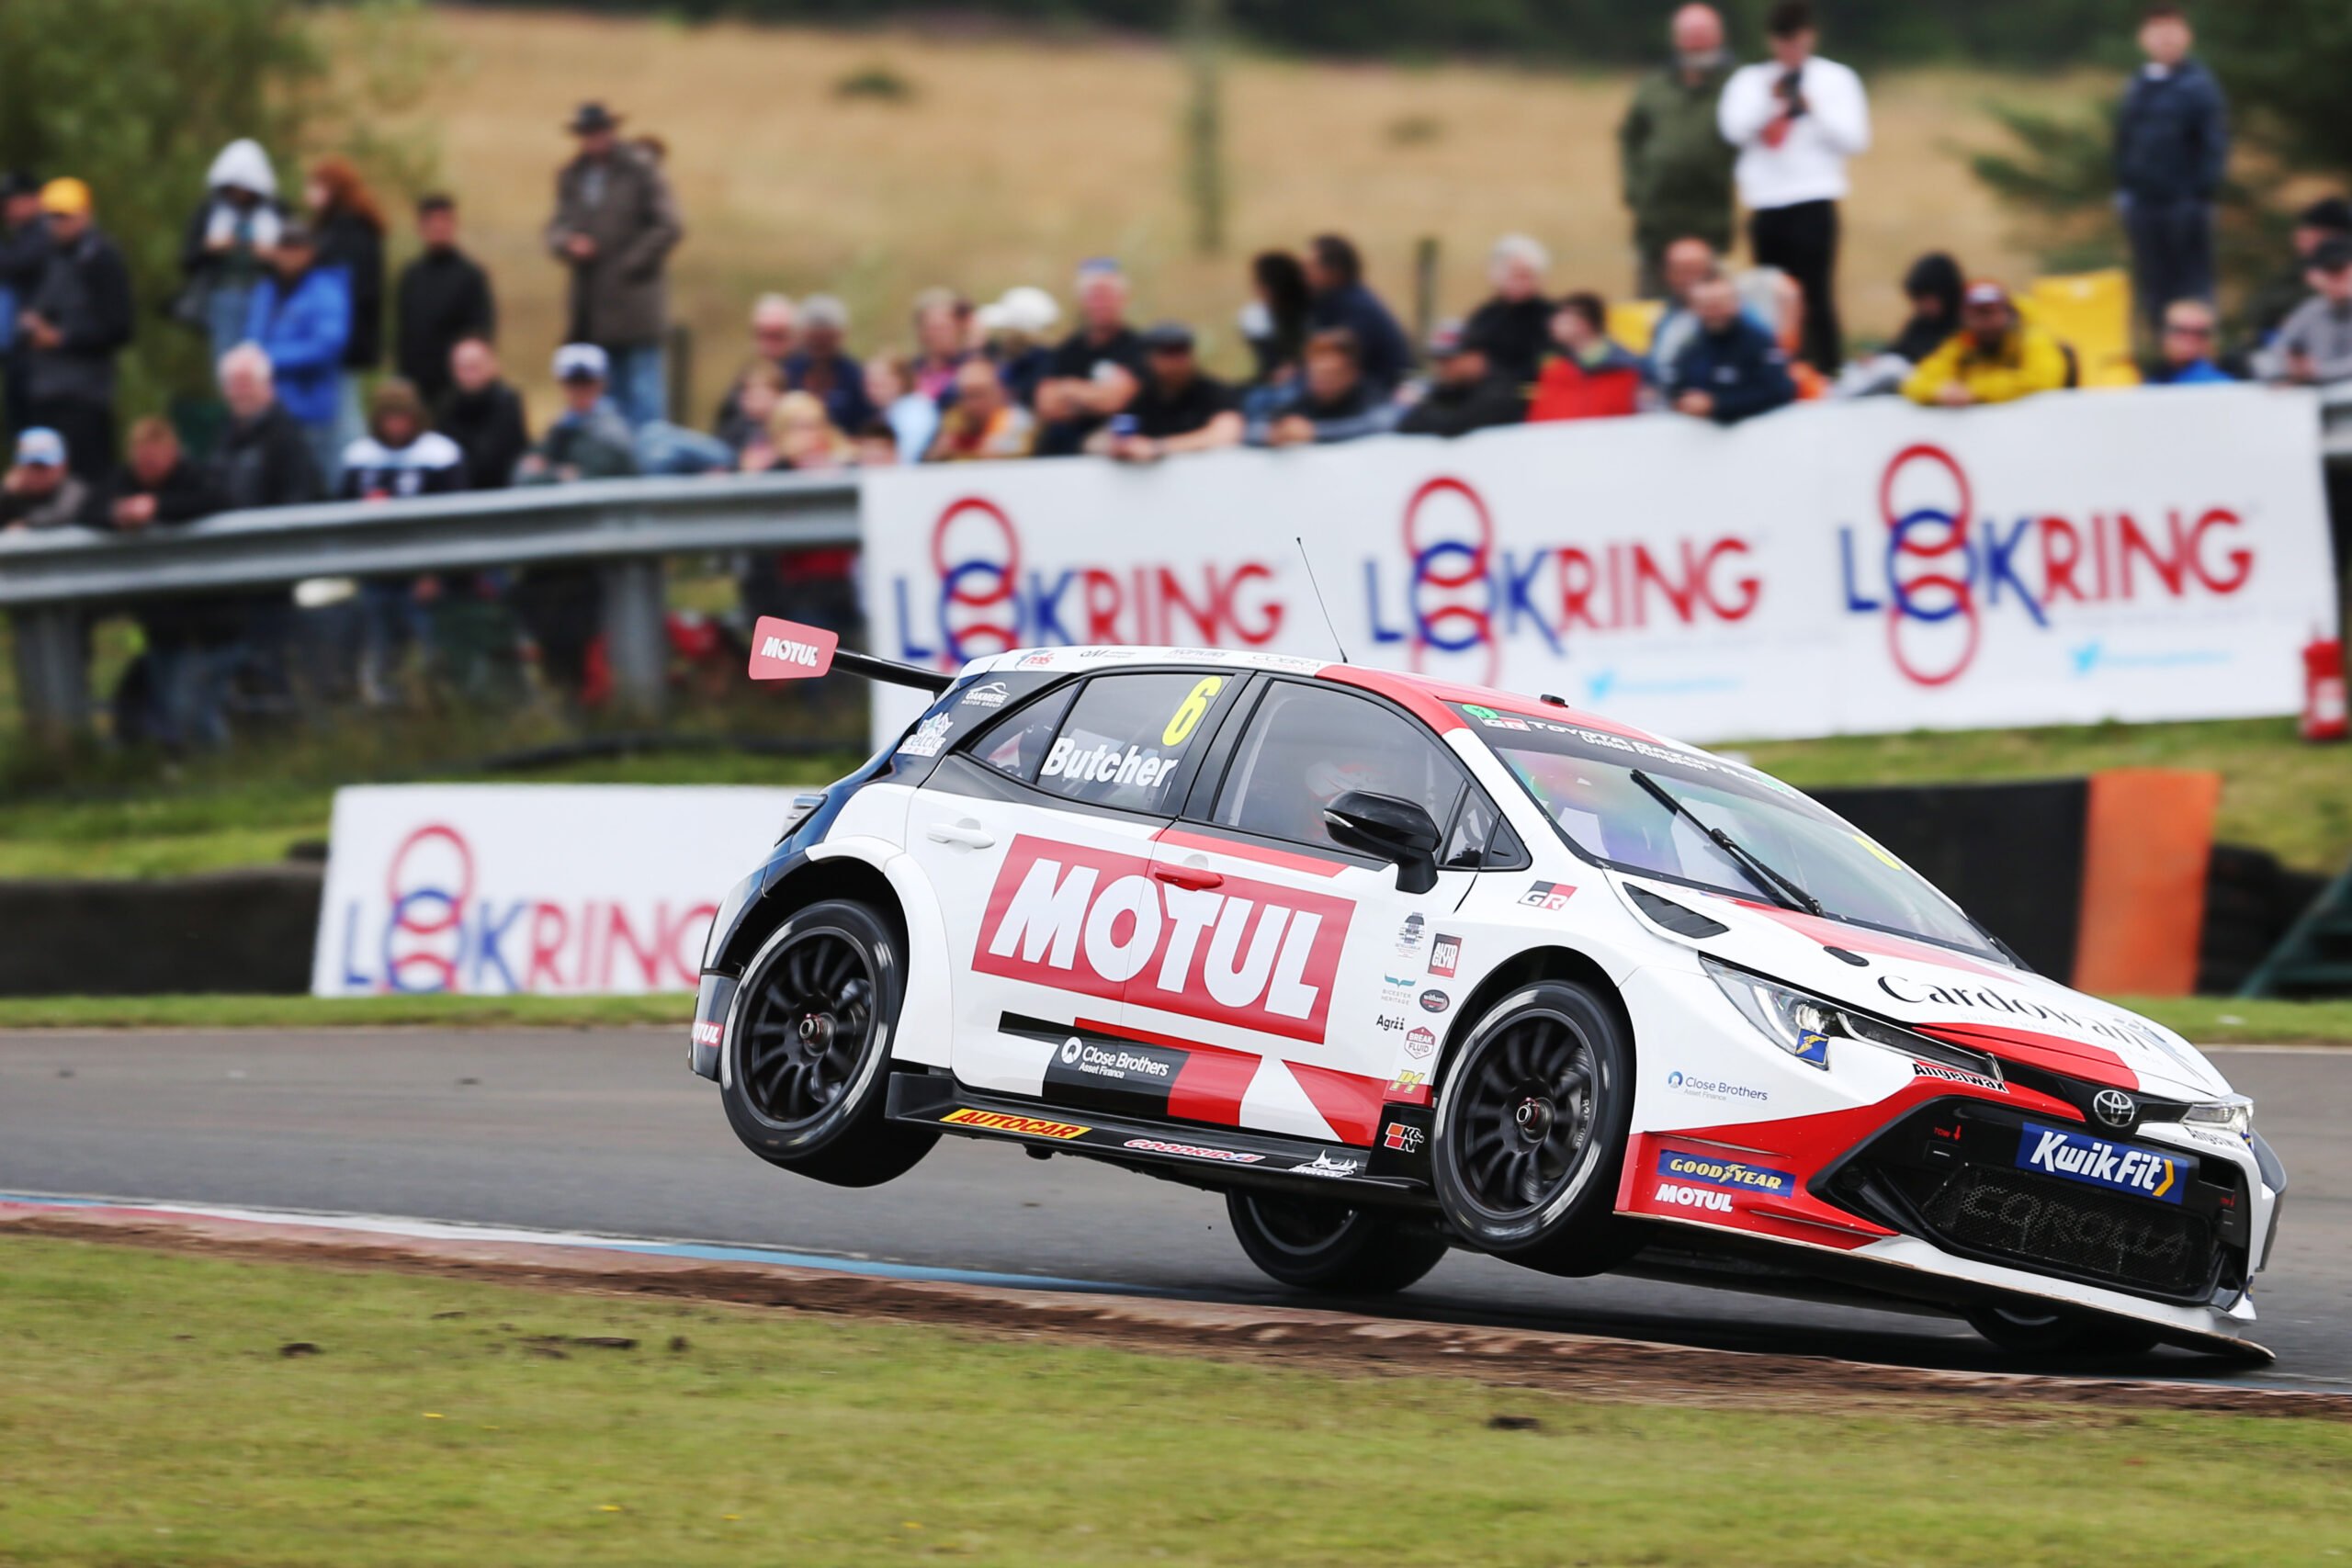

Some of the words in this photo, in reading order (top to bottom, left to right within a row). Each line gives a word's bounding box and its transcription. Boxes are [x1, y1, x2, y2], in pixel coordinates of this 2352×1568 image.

[761, 636, 819, 668] MOTUL
[966, 691, 1008, 704] OAKMERE
[1161, 675, 1223, 747] 6
[1040, 737, 1179, 787] Butcher
[1520, 890, 1569, 910] GR
[989, 857, 1323, 1020] MOTUL
[1435, 942, 1458, 957] AUTO
[1376, 1014, 1405, 1032] Agrii
[1408, 1032, 1433, 1043] BREAK
[1408, 1042, 1430, 1053] FLUID
[1079, 1062, 1099, 1075] Asset
[1099, 1066, 1125, 1079] Finance
[1082, 1045, 1115, 1066] Close
[1115, 1052, 1170, 1077] Brothers
[1685, 1077, 1716, 1091] Close
[1718, 1082, 1769, 1101] Brothers
[1912, 1063, 2007, 1092] Angelwax
[950, 1111, 1080, 1138] AUTOCAR
[1669, 1157, 1782, 1191] GOODYEAR
[1655, 1183, 1735, 1213] MOTUL
